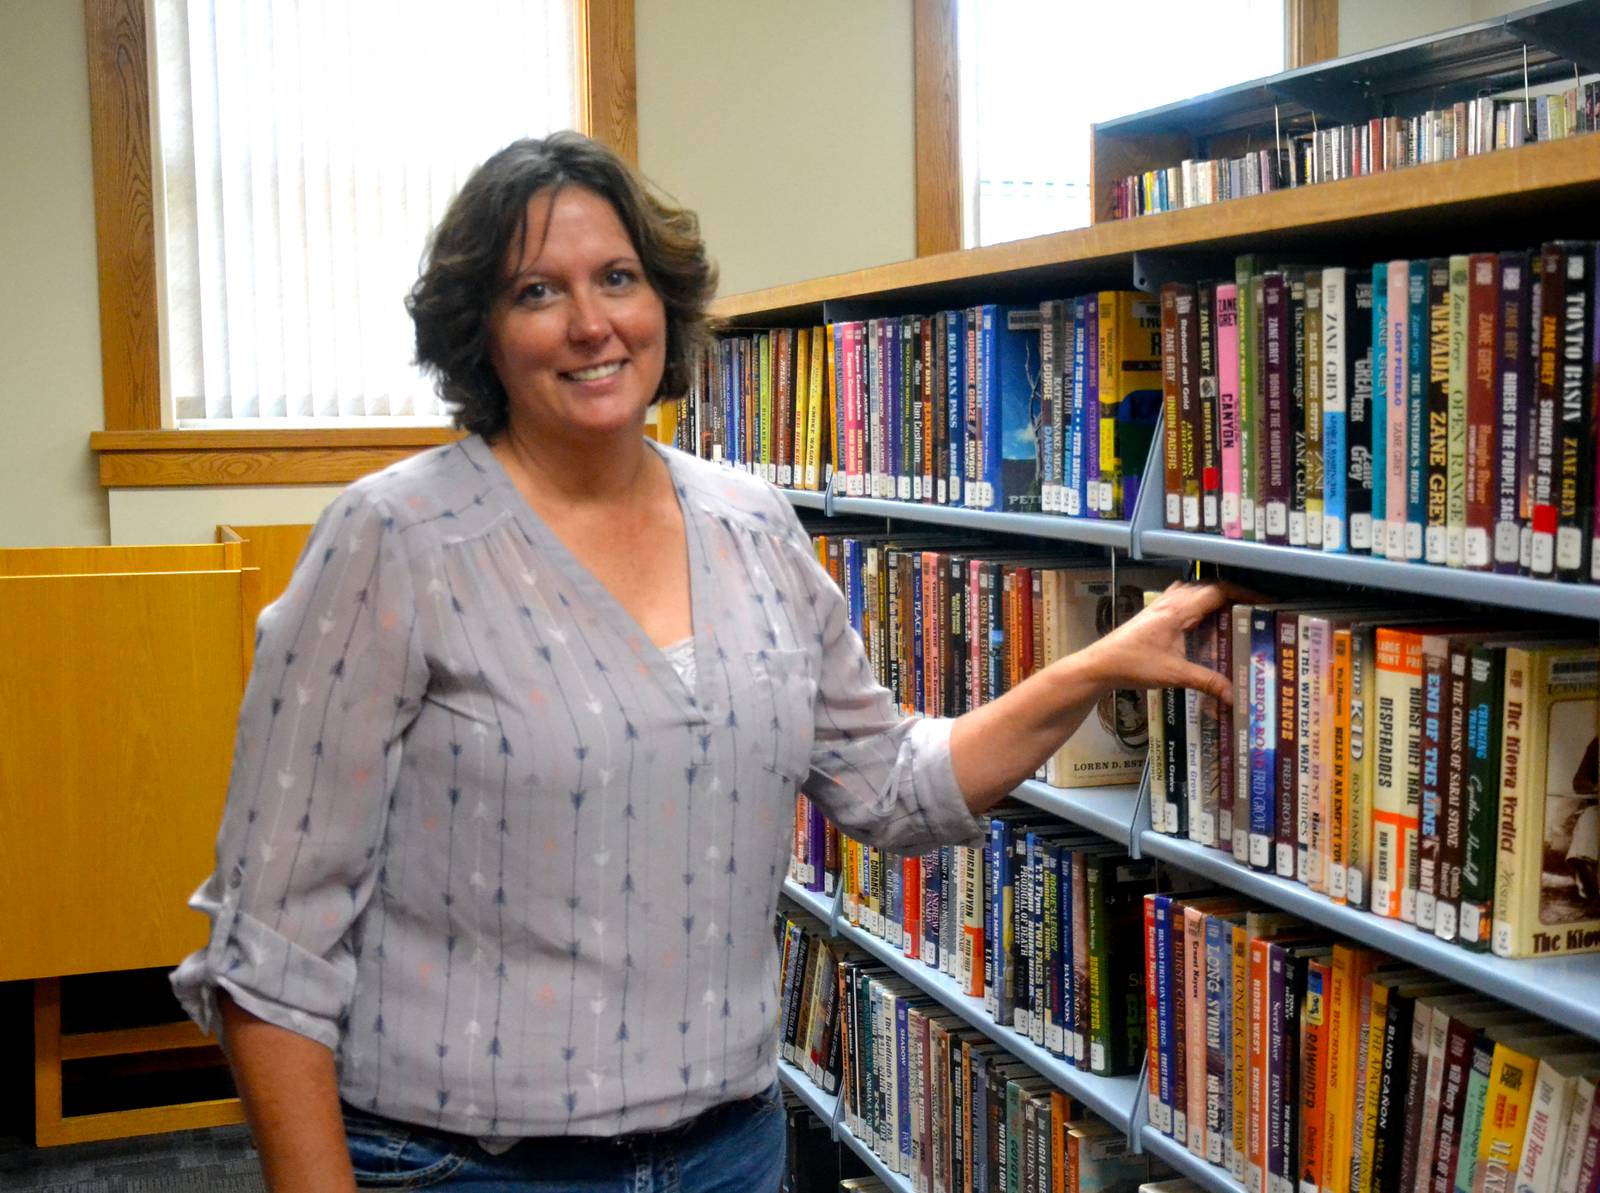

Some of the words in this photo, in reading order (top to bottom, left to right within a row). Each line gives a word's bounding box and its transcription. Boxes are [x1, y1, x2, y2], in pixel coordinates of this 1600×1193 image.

[1165, 328, 1175, 352] ZANE
[1326, 314, 1338, 354] ZANE
[1542, 317, 1556, 350] ZANE
[1564, 293, 1584, 358] TONTO
[1166, 355, 1176, 382] GREY
[1326, 361, 1338, 404] GREY
[1541, 353, 1554, 385] GREY
[1504, 373, 1517, 411] RIDERS
[1167, 396, 1177, 426] UNION
[1222, 393, 1233, 448] CANYON
[1270, 412, 1280, 429] THE
[1451, 390, 1464, 442] OPEN
[1503, 415, 1516, 426] OF
[1539, 400, 1554, 454] SHOWER
[1167, 430, 1177, 469] PACIFIC
[1430, 412, 1446, 464] ZANE
[1502, 429, 1516, 449] THE
[1501, 451, 1516, 495] PURPLE
[1538, 458, 1552, 473] OF
[1451, 454, 1464, 521] RANGE
[1538, 476, 1552, 505] GOL
[1501, 498, 1514, 522] SAG
[1282, 649, 1294, 680] SUN
[1426, 674, 1440, 712] END
[1282, 686, 1293, 740] DANCE
[1351, 700, 1364, 761] KID
[1426, 719, 1439, 741] OF
[1074, 761, 1109, 771] LOREN
[1424, 748, 1438, 785] THE
[1423, 792, 1436, 836] LINE
[967, 848, 975, 879] OUGAR
[1533, 932, 1560, 953] The
